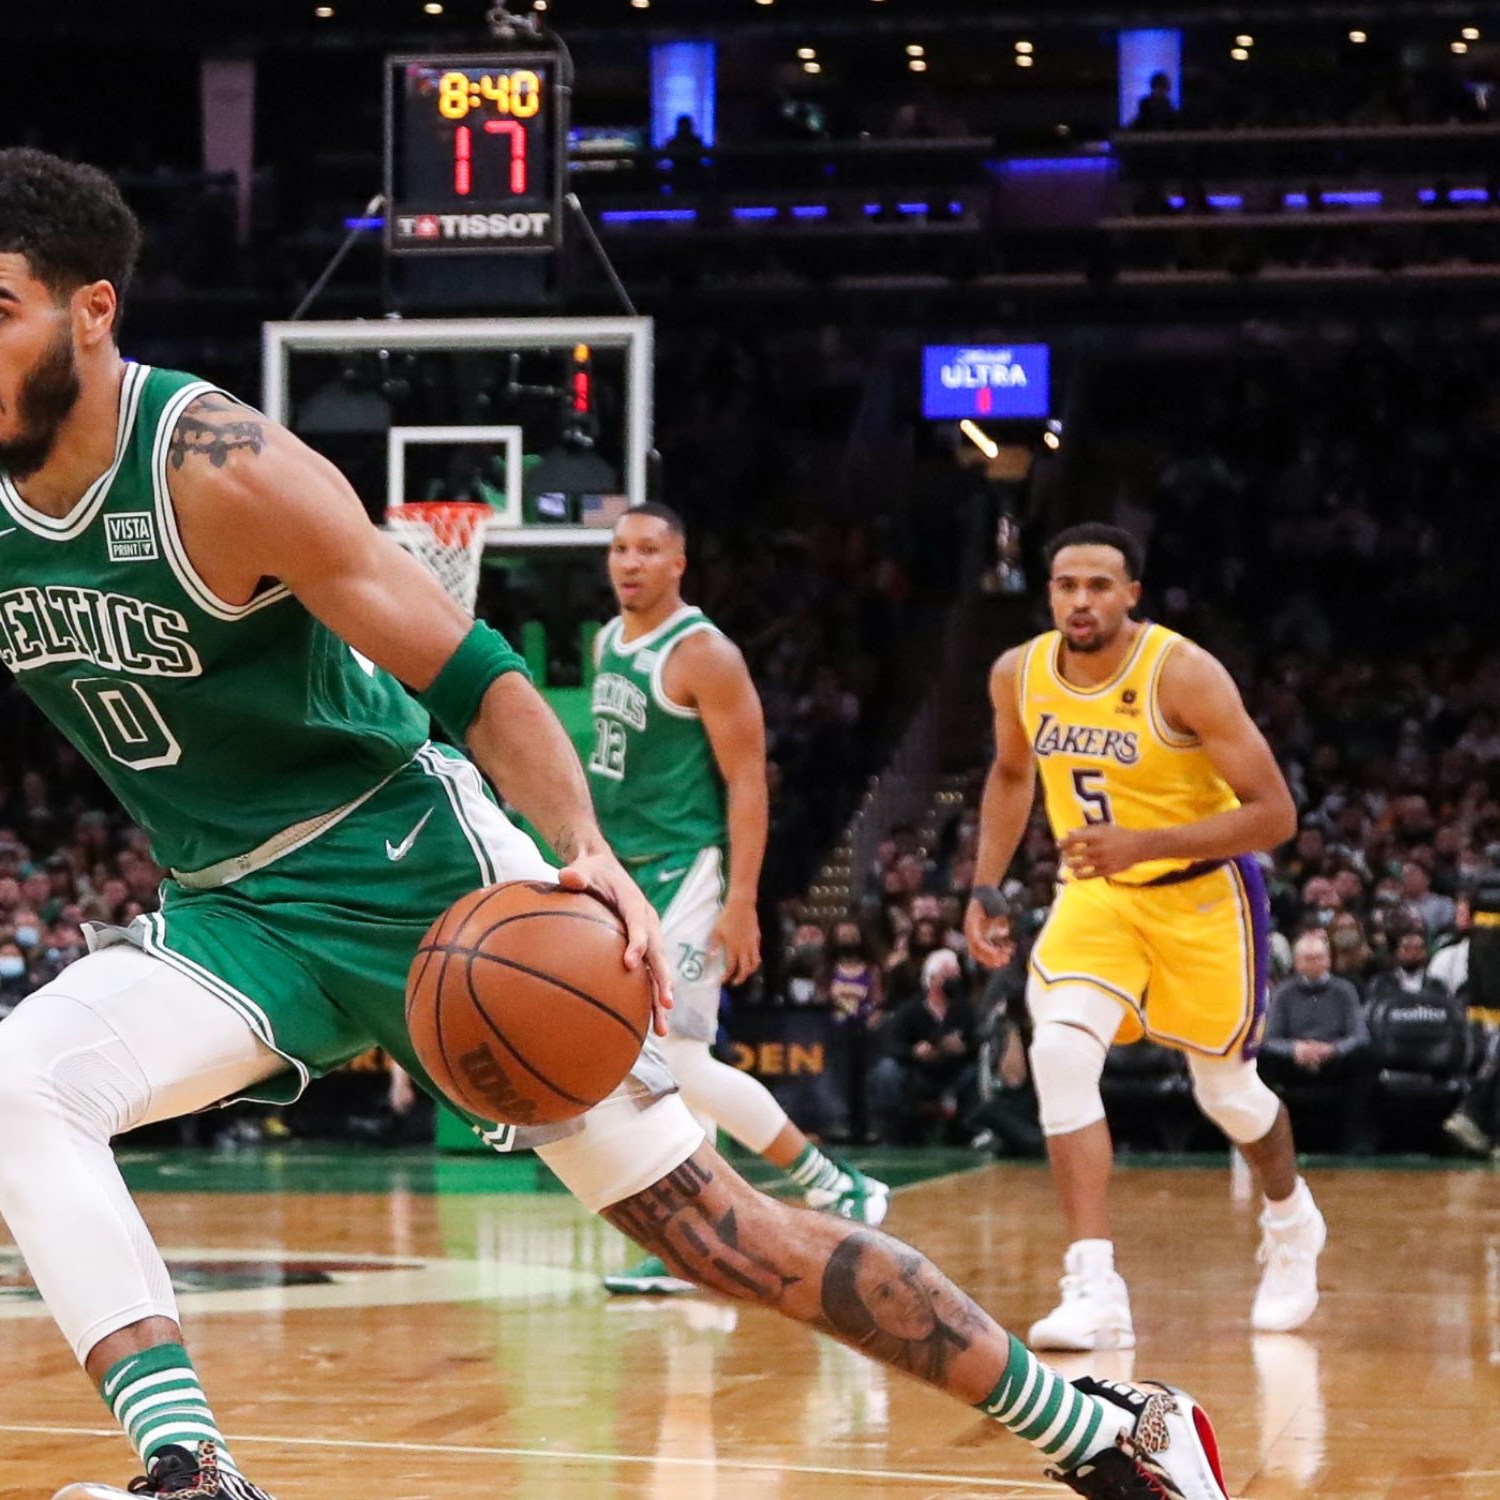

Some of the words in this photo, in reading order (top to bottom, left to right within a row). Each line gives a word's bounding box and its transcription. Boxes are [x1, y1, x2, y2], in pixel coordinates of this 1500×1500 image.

[438, 70, 540, 120] 8:40
[454, 119, 527, 196] 17
[440, 212, 550, 238] TISSOT
[940, 363, 1027, 389] ULTRA
[109, 518, 151, 540] VISTA
[112, 543, 138, 557] PRINT
[71, 677, 182, 771] 0
[1033, 713, 1141, 766] LAKERS
[1070, 767, 1114, 827] 5
